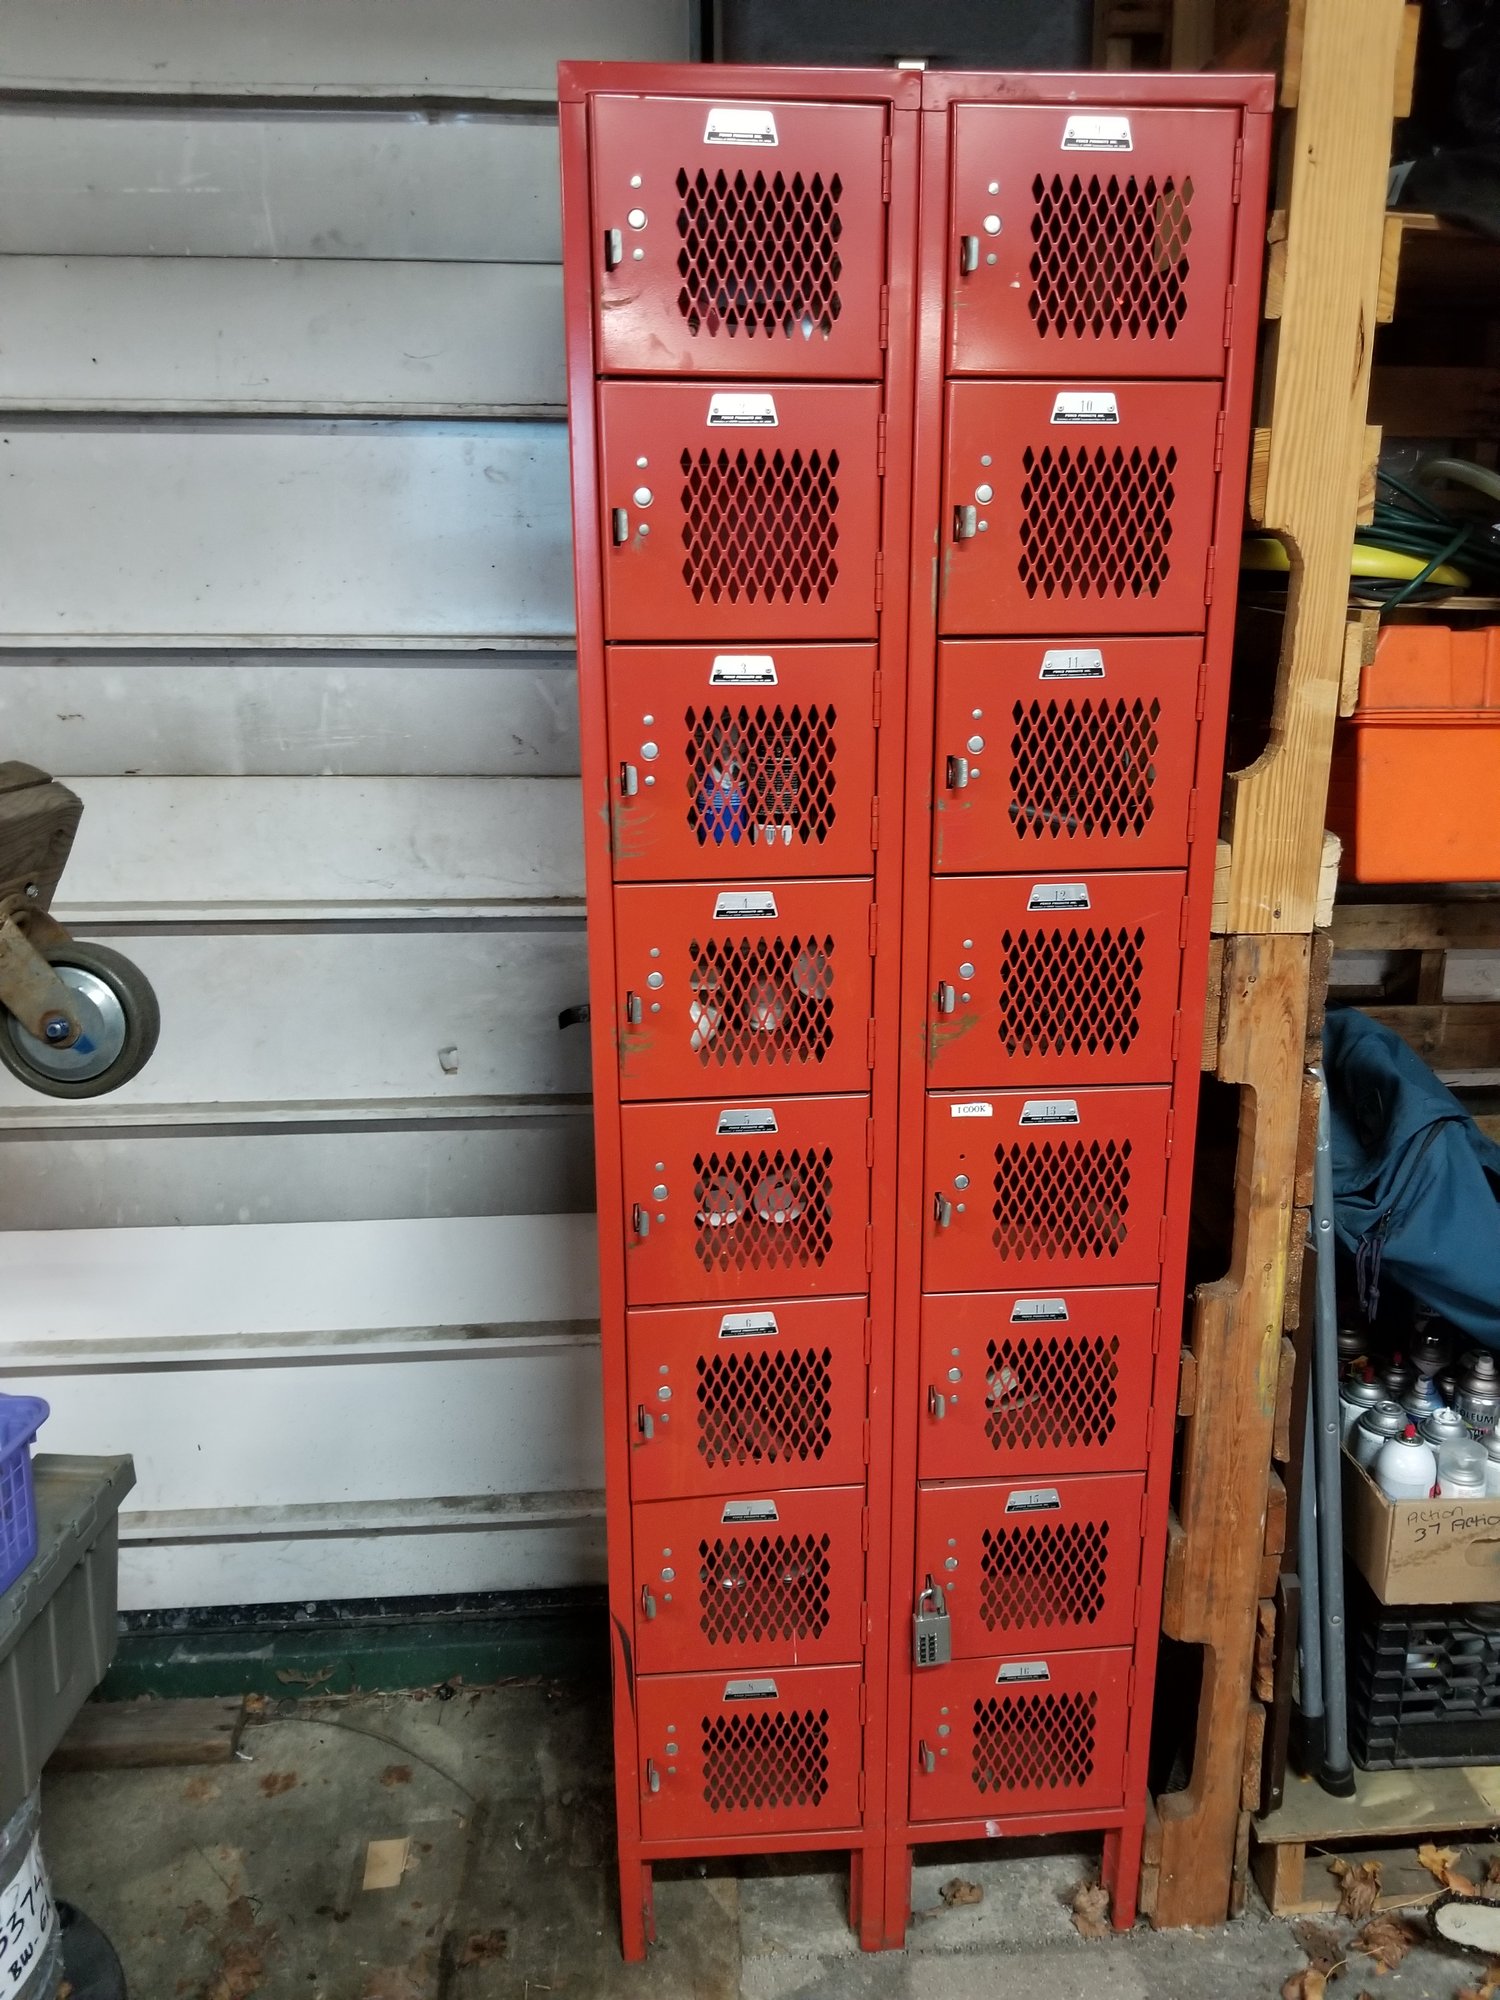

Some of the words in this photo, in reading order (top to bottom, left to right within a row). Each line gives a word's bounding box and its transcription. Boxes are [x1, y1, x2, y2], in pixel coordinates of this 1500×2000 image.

[1081, 400, 1093, 412] 10
[1055, 889, 1066, 901] 12
[963, 1105, 986, 1113] COOK
[1046, 1105, 1056, 1116] 13
[1414, 1522, 1441, 1543] 37
